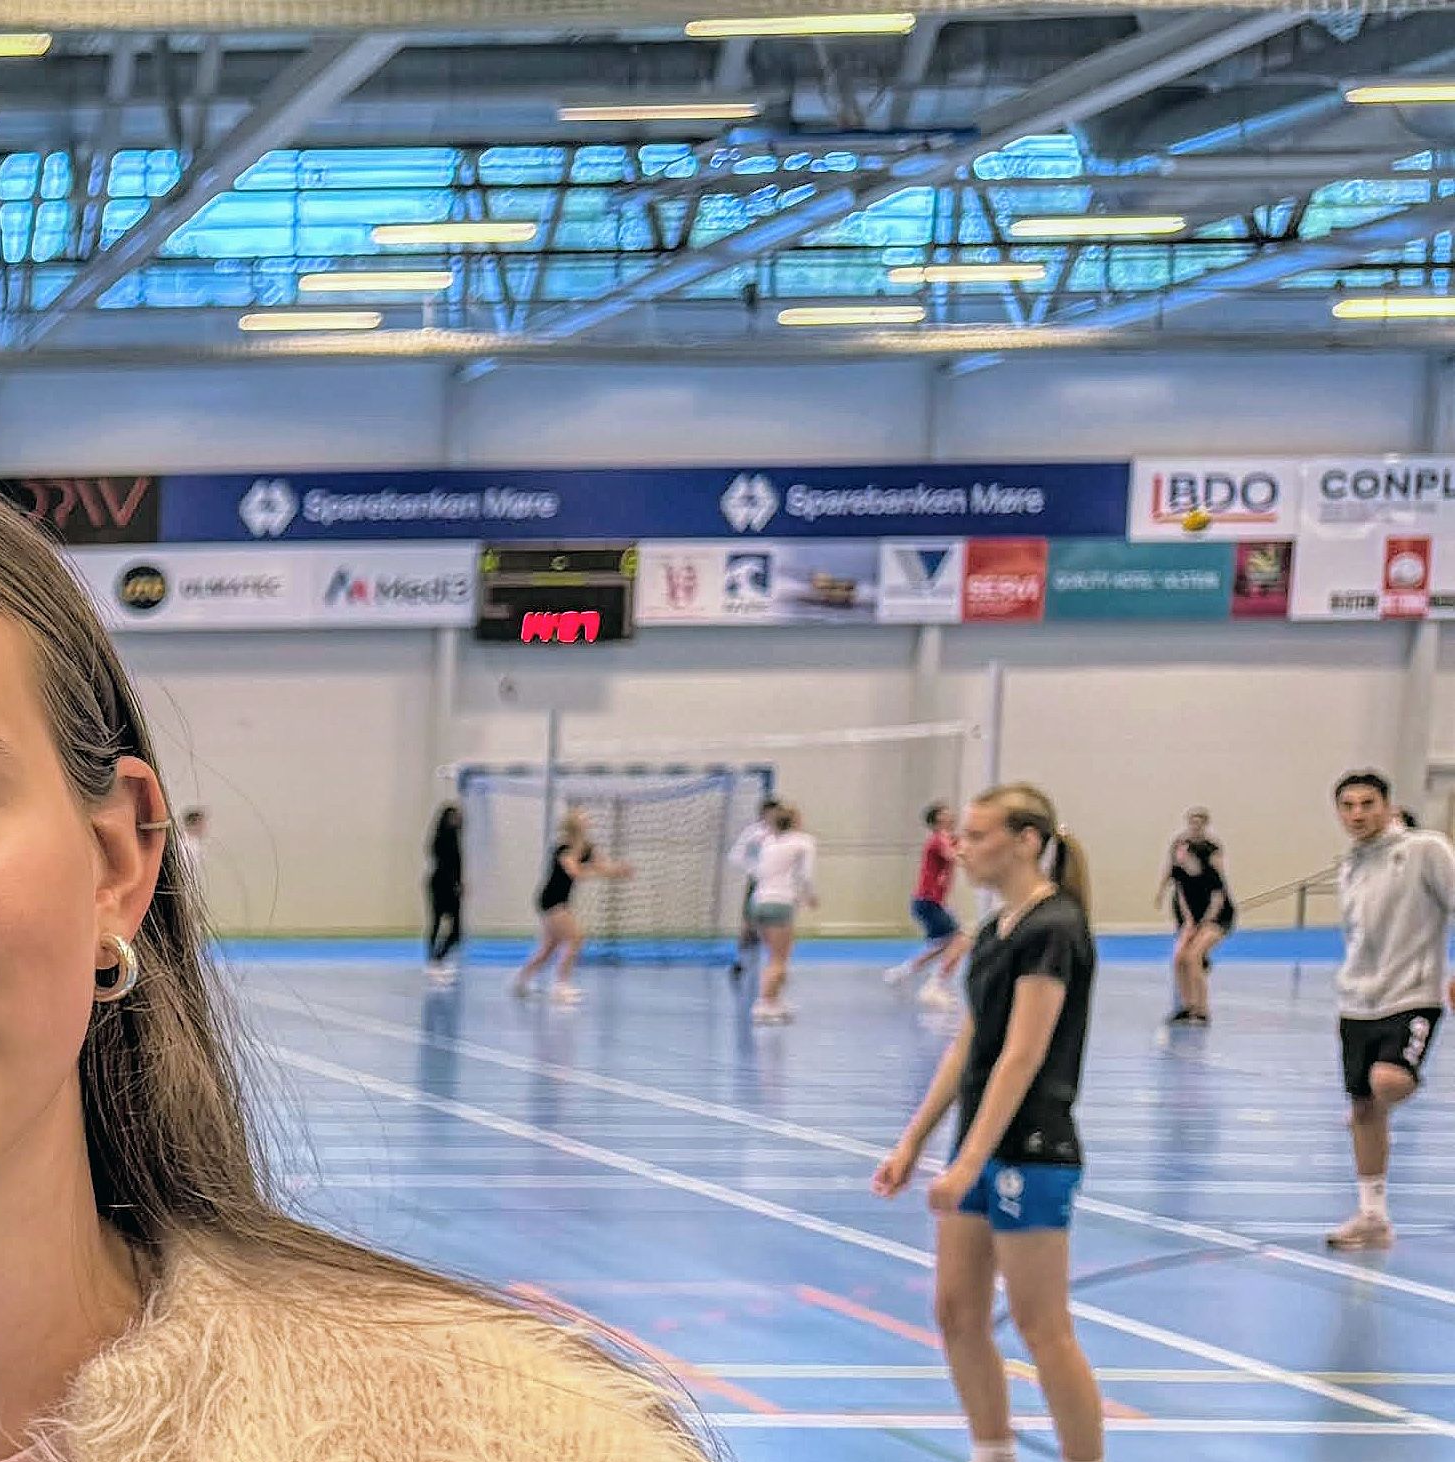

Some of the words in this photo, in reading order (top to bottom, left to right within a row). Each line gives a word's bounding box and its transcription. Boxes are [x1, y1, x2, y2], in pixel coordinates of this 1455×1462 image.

[303, 488, 482, 524] Sparebanken
[786, 484, 967, 523] Sparebanken
[1169, 471, 1279, 513] BDO
